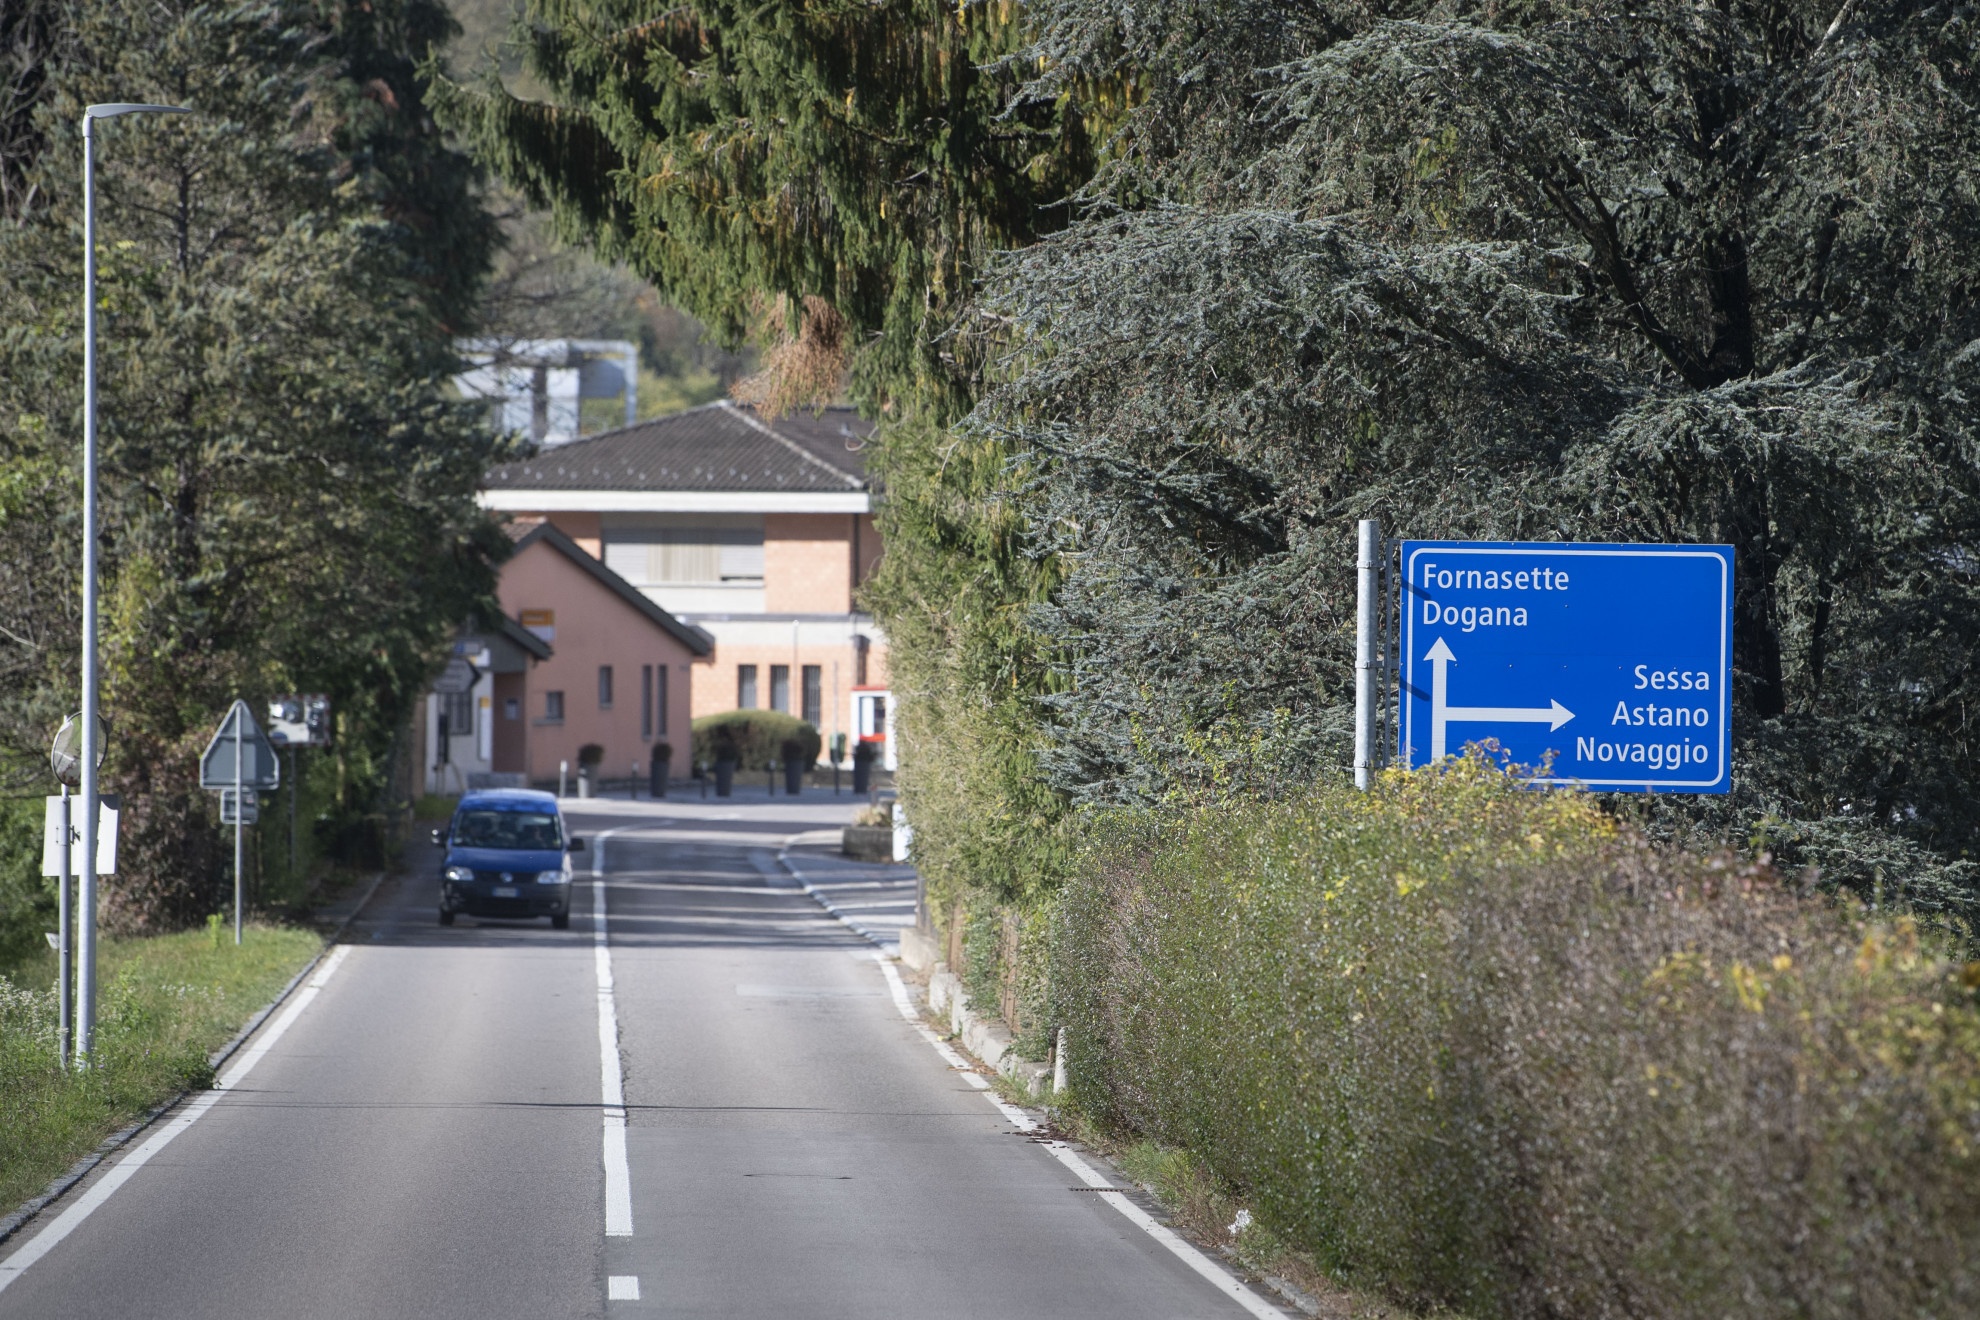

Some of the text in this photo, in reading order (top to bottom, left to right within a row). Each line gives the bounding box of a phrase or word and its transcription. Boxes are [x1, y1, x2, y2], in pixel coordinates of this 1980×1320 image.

[1424, 563, 1569, 591] Fornasette
[1423, 600, 1528, 633] Dogana
[1634, 664, 1709, 691] Sessa
[1611, 701, 1709, 727] Astano
[1576, 736, 1708, 770] Novaggio
